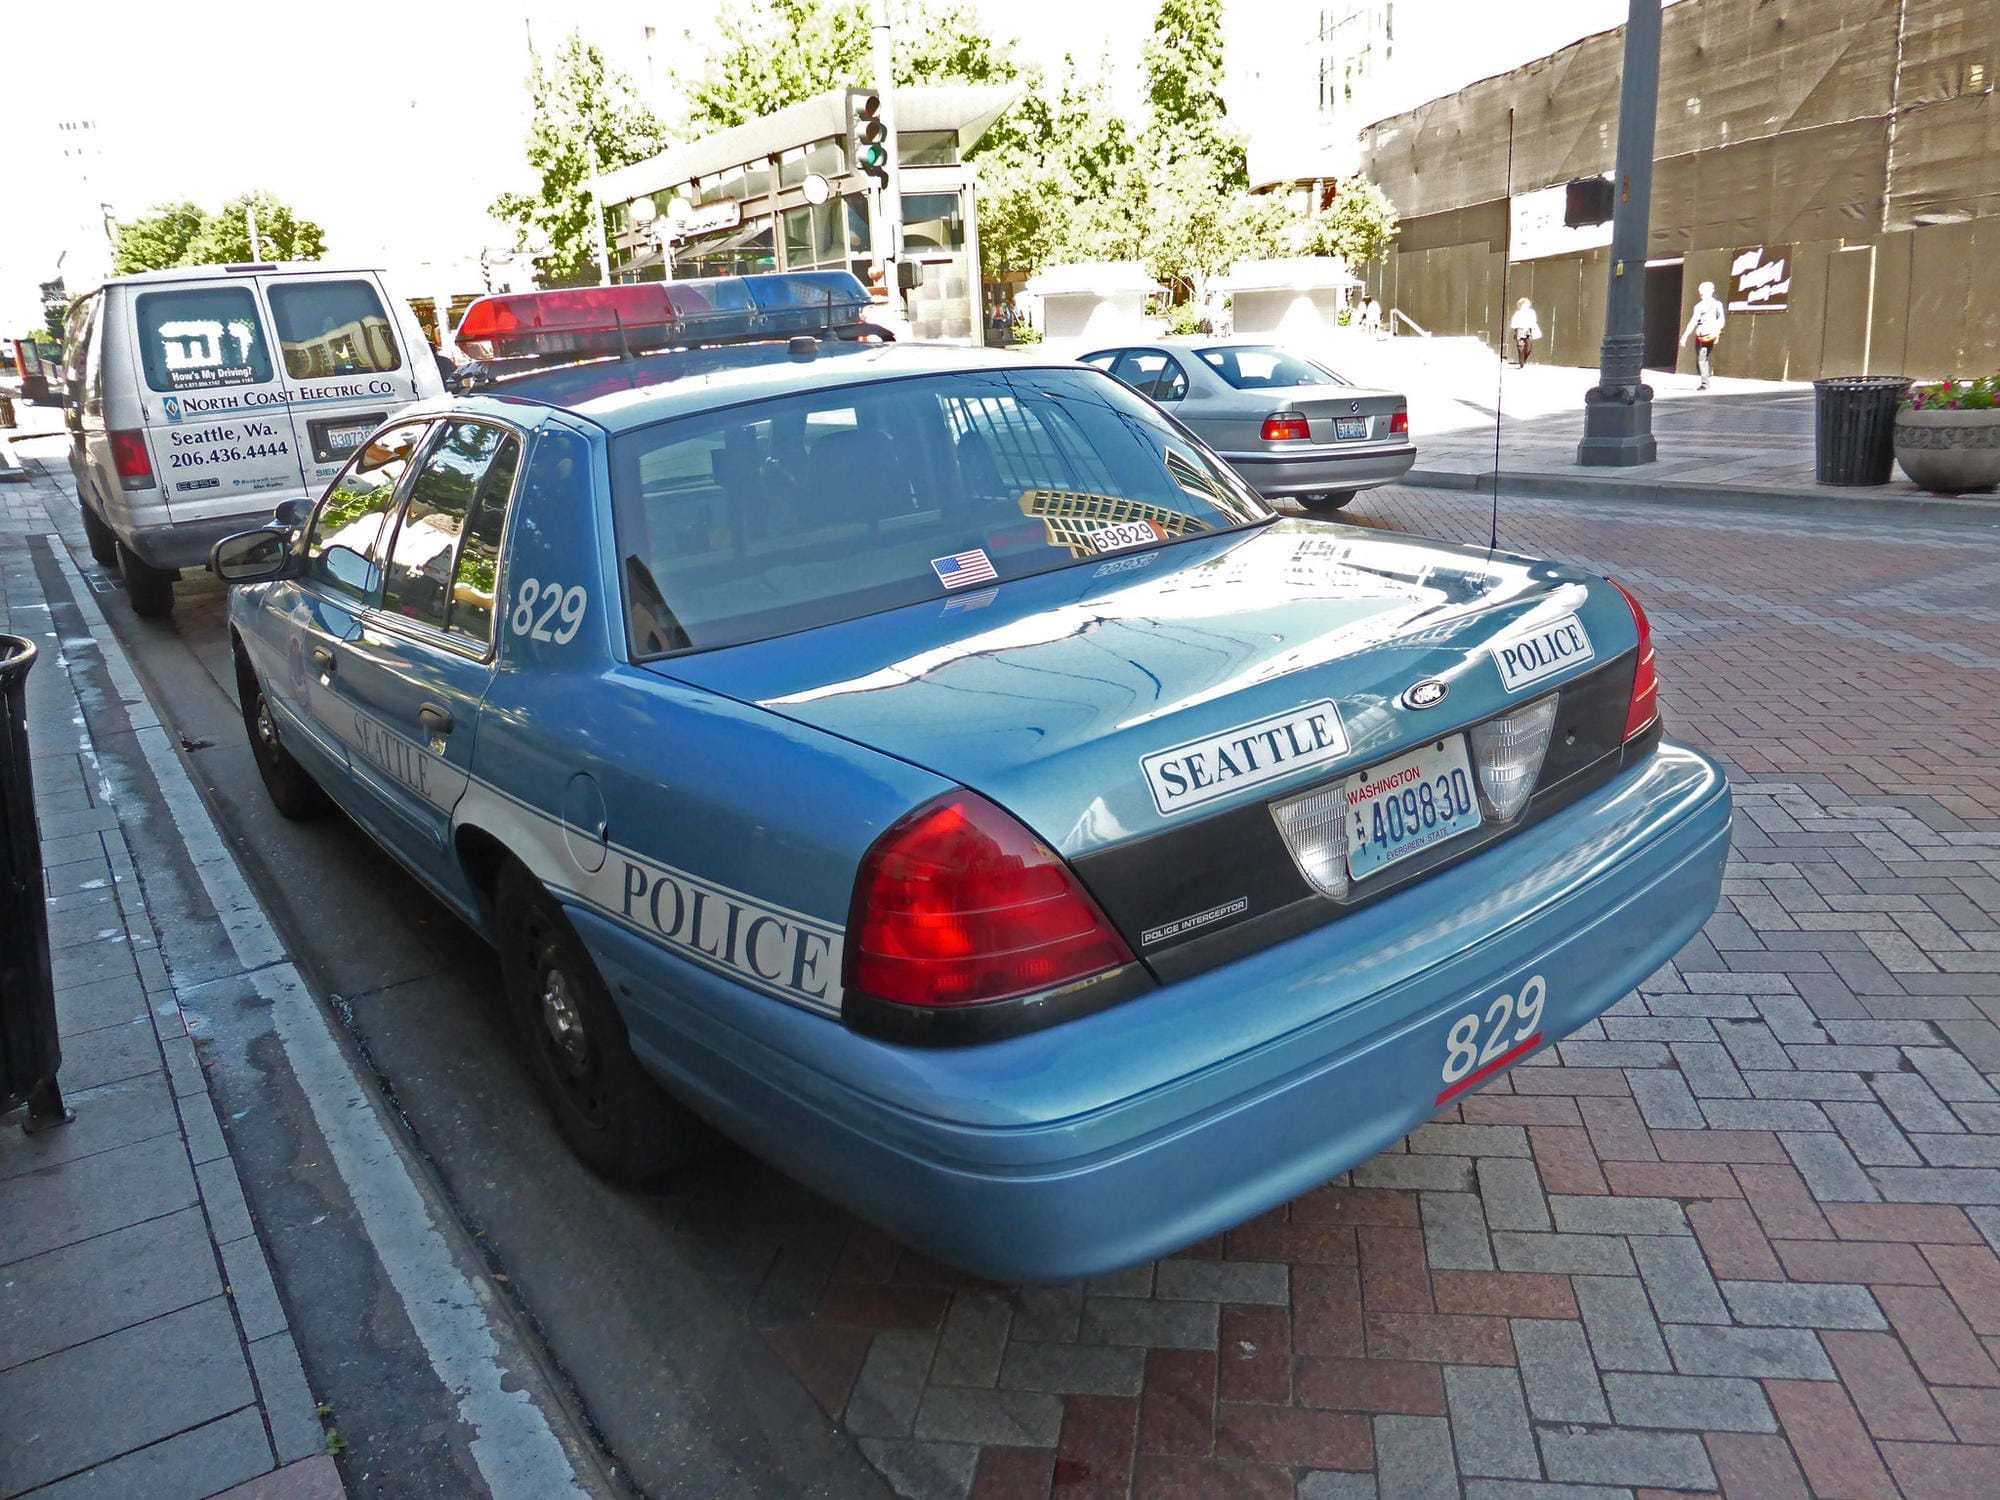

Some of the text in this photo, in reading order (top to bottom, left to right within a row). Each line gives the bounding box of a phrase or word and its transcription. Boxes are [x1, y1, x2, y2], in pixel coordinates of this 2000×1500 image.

[171, 367, 252, 381] How's My Driving?
[183, 380, 396, 412] NORTH COAST ELECTRIC CO.
[171, 422, 278, 446] Seattle, Wa.
[169, 441, 288, 468] 206.436.4444
[176, 478, 220, 491] E250
[1092, 523, 1154, 549] 59829
[512, 578, 587, 645] 829
[1500, 624, 1585, 678] POLICE
[354, 711, 432, 798] SEATTLE
[1159, 714, 1334, 799] SEATTLE
[1346, 766, 1420, 805] WASHINGTON
[1386, 827, 1449, 861] EVERGREEN STATE
[621, 860, 831, 1000] POLICE
[1144, 900, 1244, 942] POLICE INTERCEPTOR
[1442, 975, 1546, 1083] 829
